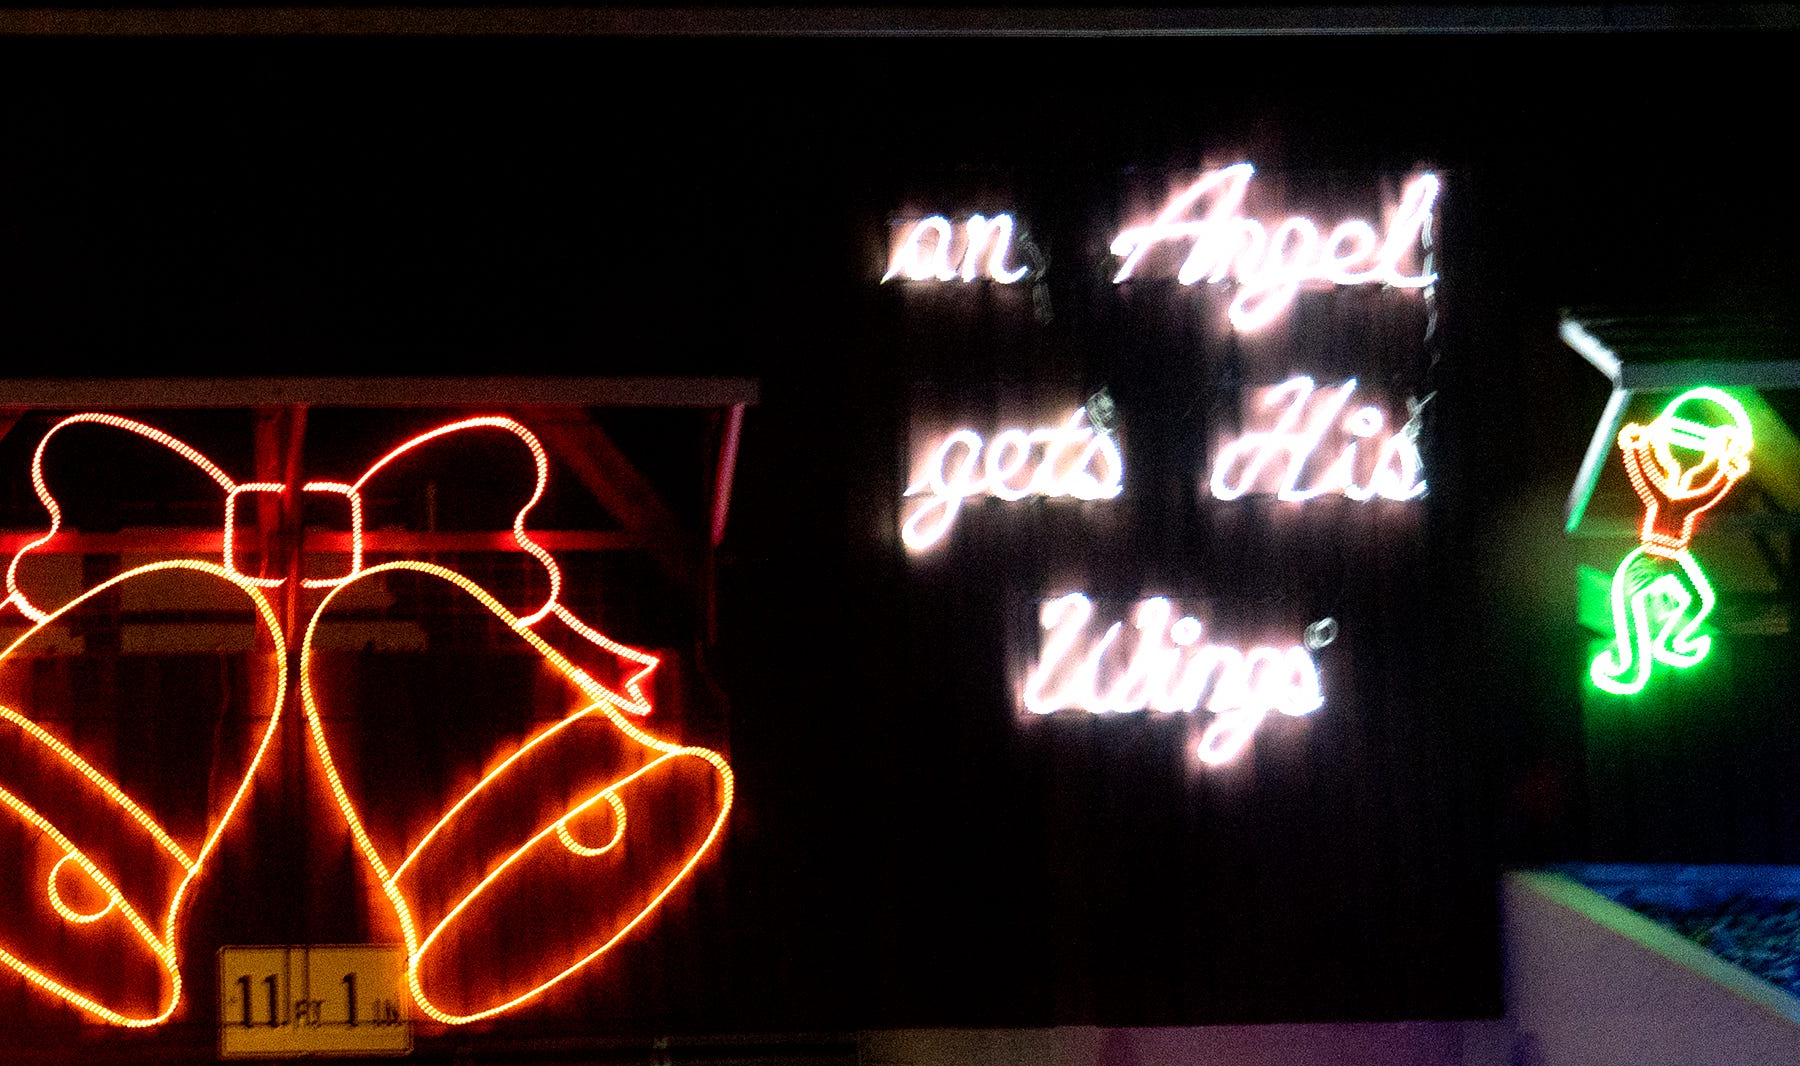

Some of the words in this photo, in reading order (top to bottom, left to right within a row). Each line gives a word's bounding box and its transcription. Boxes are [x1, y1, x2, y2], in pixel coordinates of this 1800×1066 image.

[880, 212, 1028, 285] an
[1110, 162, 1440, 333] Angel
[901, 403, 1124, 552] gets
[1209, 375, 1427, 501] His
[1023, 591, 1325, 765] Wings
[238, 973, 281, 1029] 11
[342, 971, 359, 1028] 1
